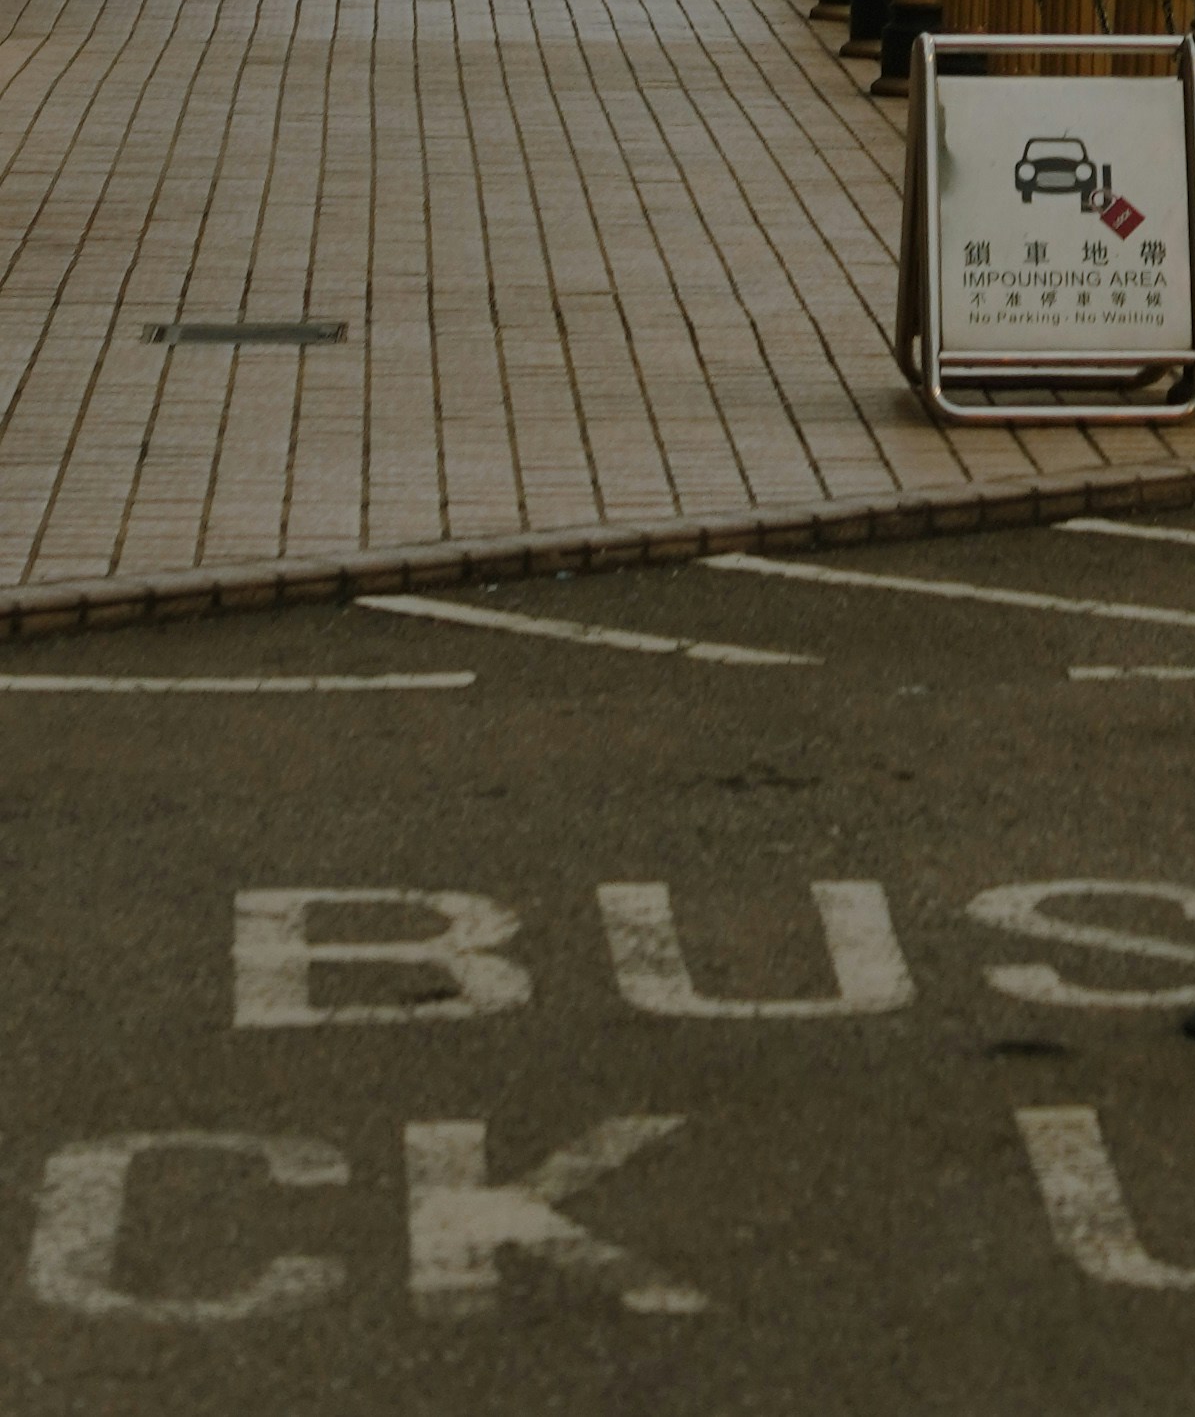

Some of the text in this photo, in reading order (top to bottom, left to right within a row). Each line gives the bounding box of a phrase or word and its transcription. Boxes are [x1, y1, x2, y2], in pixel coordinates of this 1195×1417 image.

[963, 239, 1167, 267] 鎖車地帶
[962, 270, 1168, 288] IMPOUNDING AREA
[968, 310, 1165, 328] No Parking No Waiting
